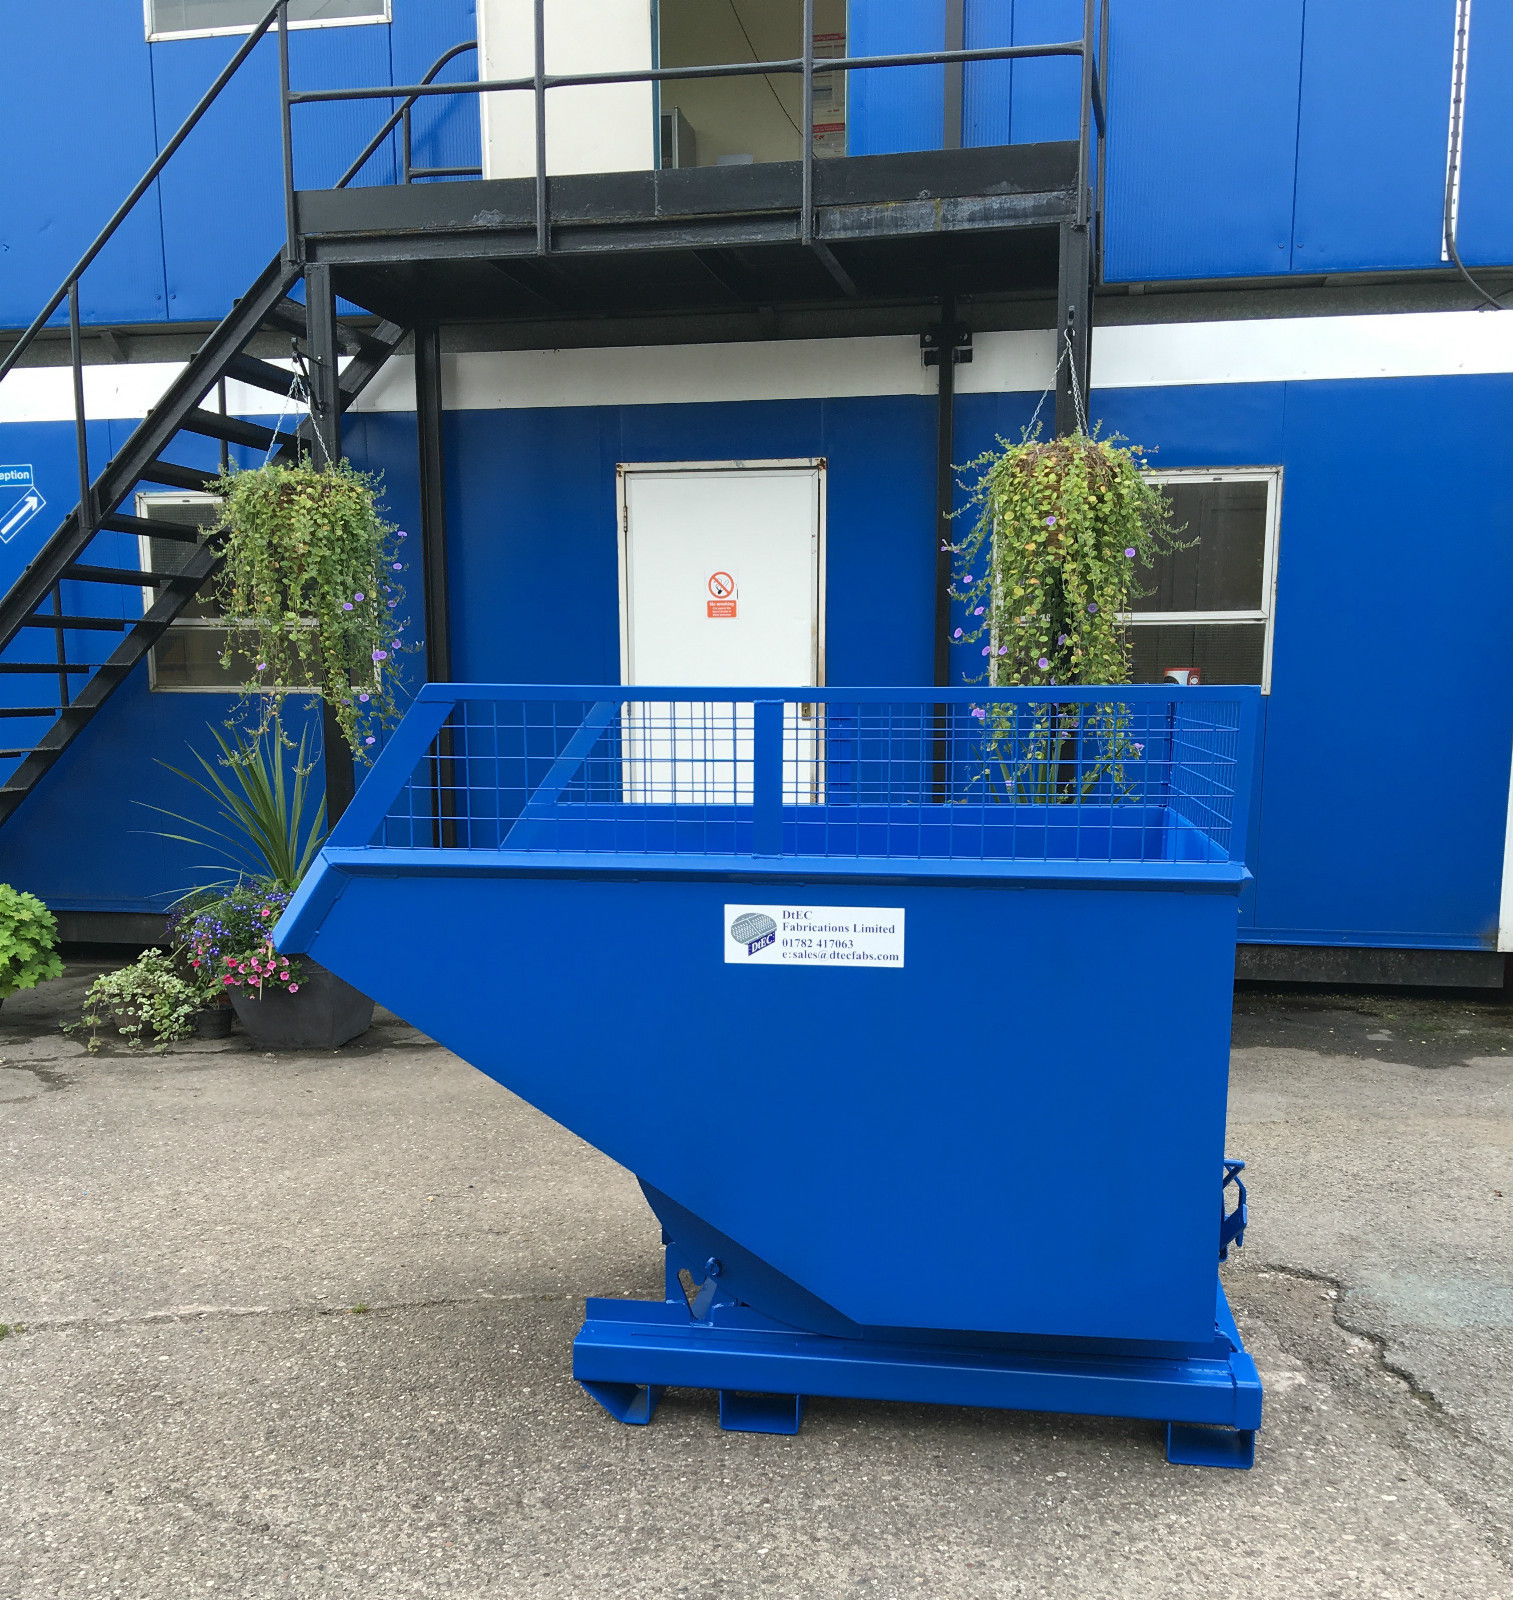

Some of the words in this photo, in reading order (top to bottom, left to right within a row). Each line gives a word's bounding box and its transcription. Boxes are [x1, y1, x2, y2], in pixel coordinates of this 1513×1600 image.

[782, 910, 813, 920] DtEC
[782, 922, 850, 934] Fabrications
[853, 923, 896, 935] Limited
[751, 935, 773, 953] DtEC
[782, 938, 813, 948] 01782
[816, 939, 854, 949] 417063
